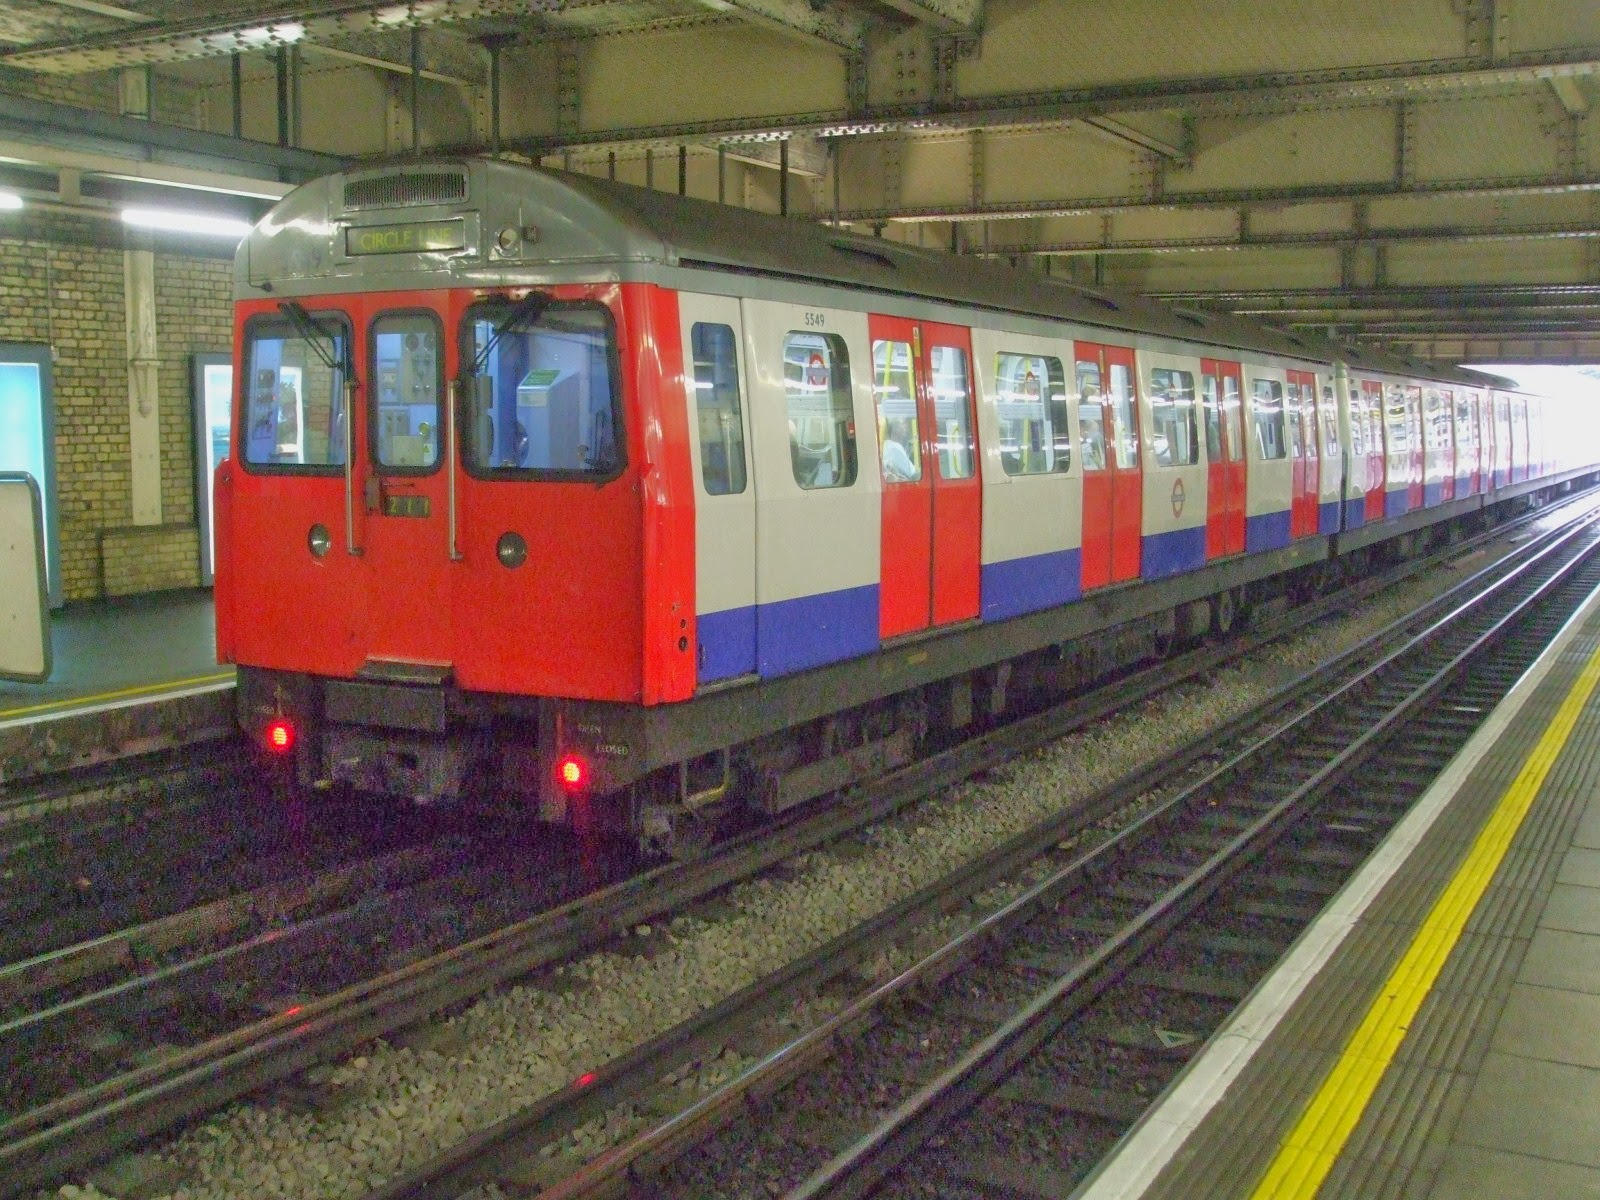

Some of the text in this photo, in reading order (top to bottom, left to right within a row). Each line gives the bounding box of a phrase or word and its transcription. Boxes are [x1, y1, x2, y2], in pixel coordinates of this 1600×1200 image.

[360, 227, 453, 250] CIRCLE LINE
[805, 312, 825, 327] 5549
[389, 496, 430, 514] 211
